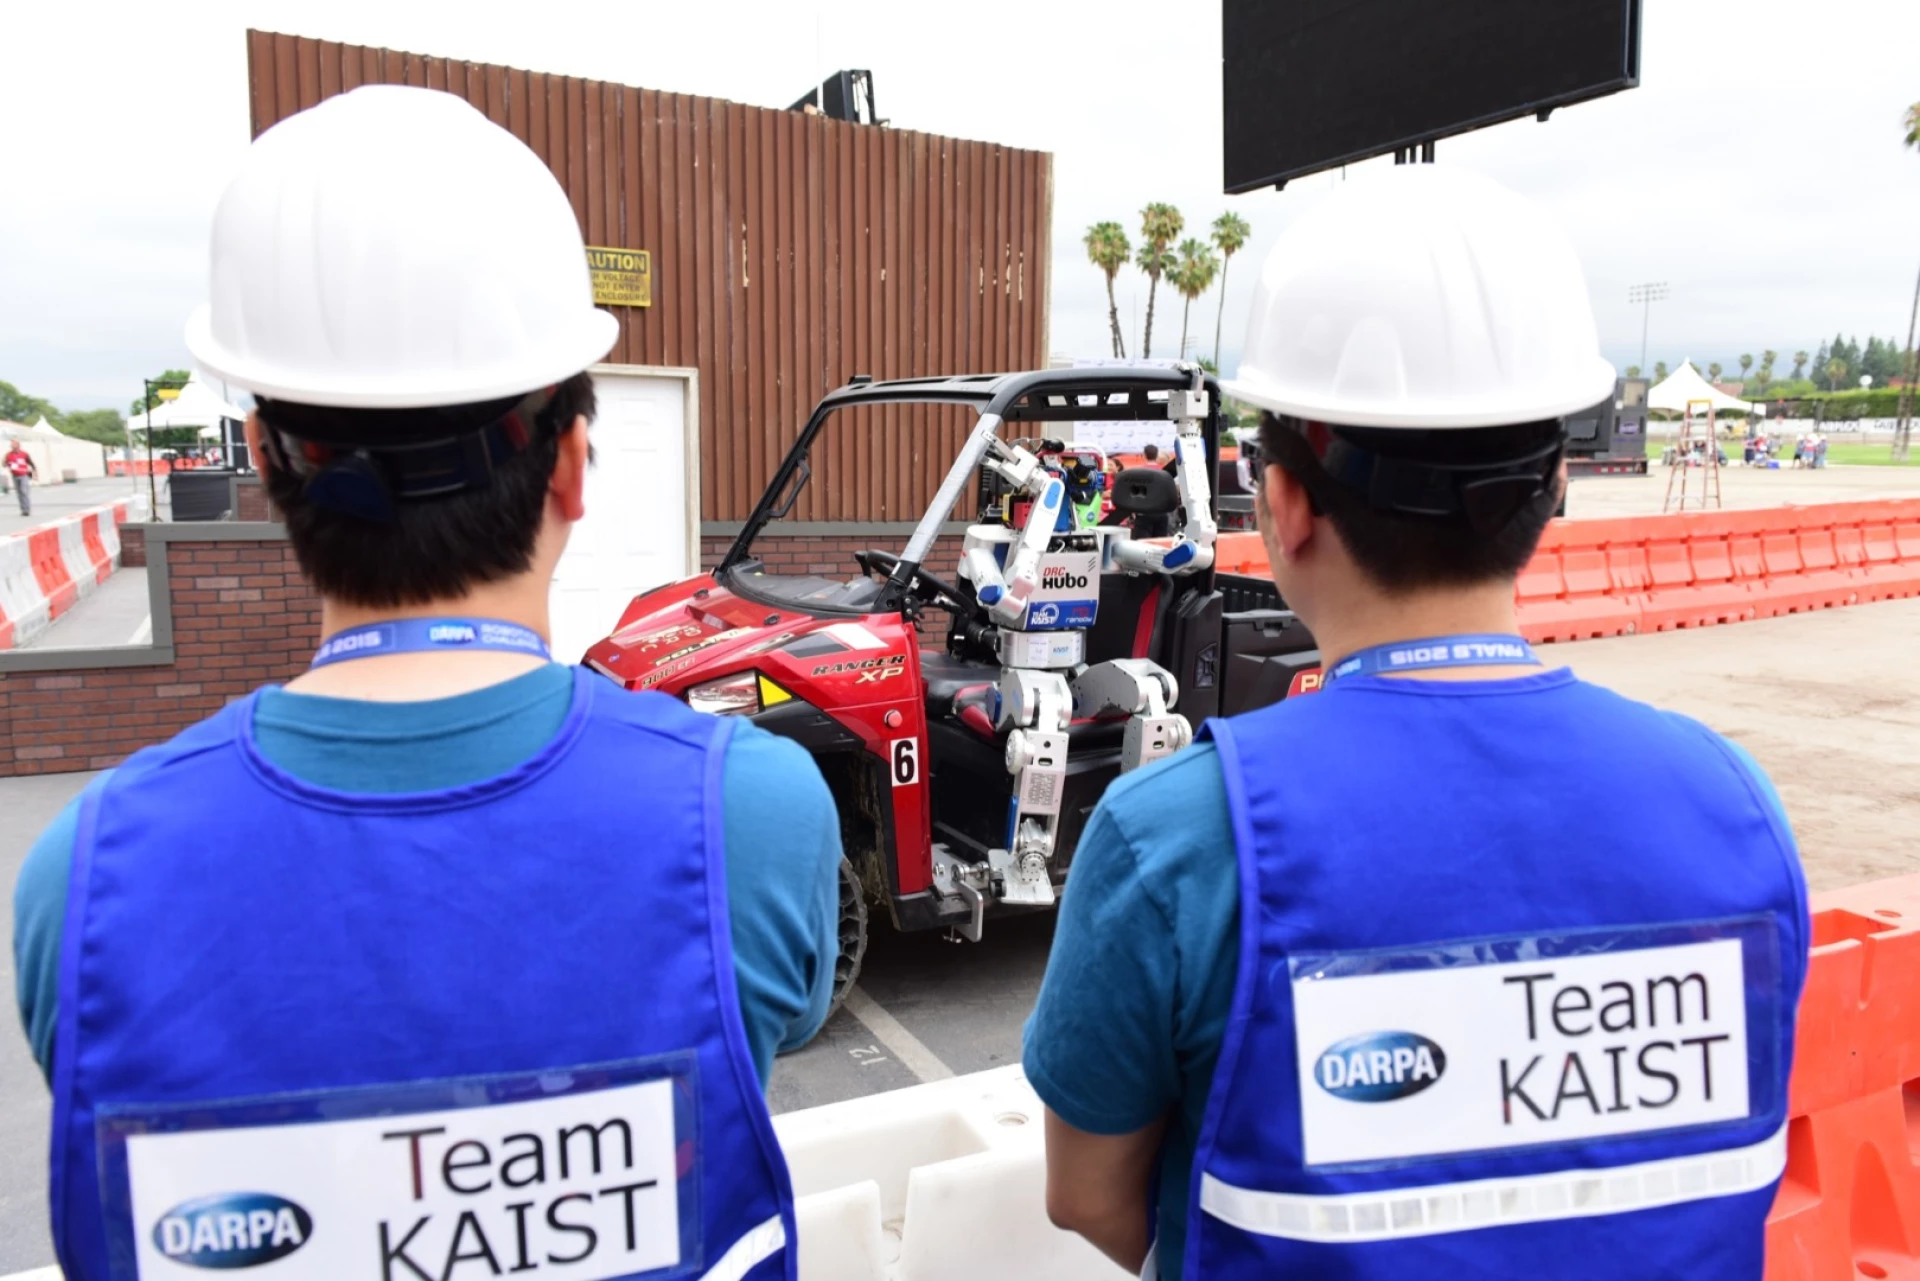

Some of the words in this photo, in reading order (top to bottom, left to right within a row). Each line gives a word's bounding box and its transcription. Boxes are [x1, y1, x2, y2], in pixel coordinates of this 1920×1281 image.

[586, 251, 646, 271] AUTION
[602, 272, 640, 282] VOLTAGE
[613, 282, 641, 292] ENTER
[595, 291, 647, 302] ENCLOSURE
[1043, 566, 1066, 577] DRC
[331, 630, 382, 654] 2015
[810, 655, 907, 677] RANGER
[1389, 646, 1449, 666] 2015
[854, 666, 905, 685] XP
[893, 739, 917, 784] 6
[1502, 971, 1711, 1041] Team
[1321, 1045, 1438, 1089] DARPA
[1499, 1033, 1731, 1126] KAIST
[381, 1115, 635, 1202] Team
[161, 1206, 304, 1257] DARPA
[377, 1178, 659, 1281] KAIST
